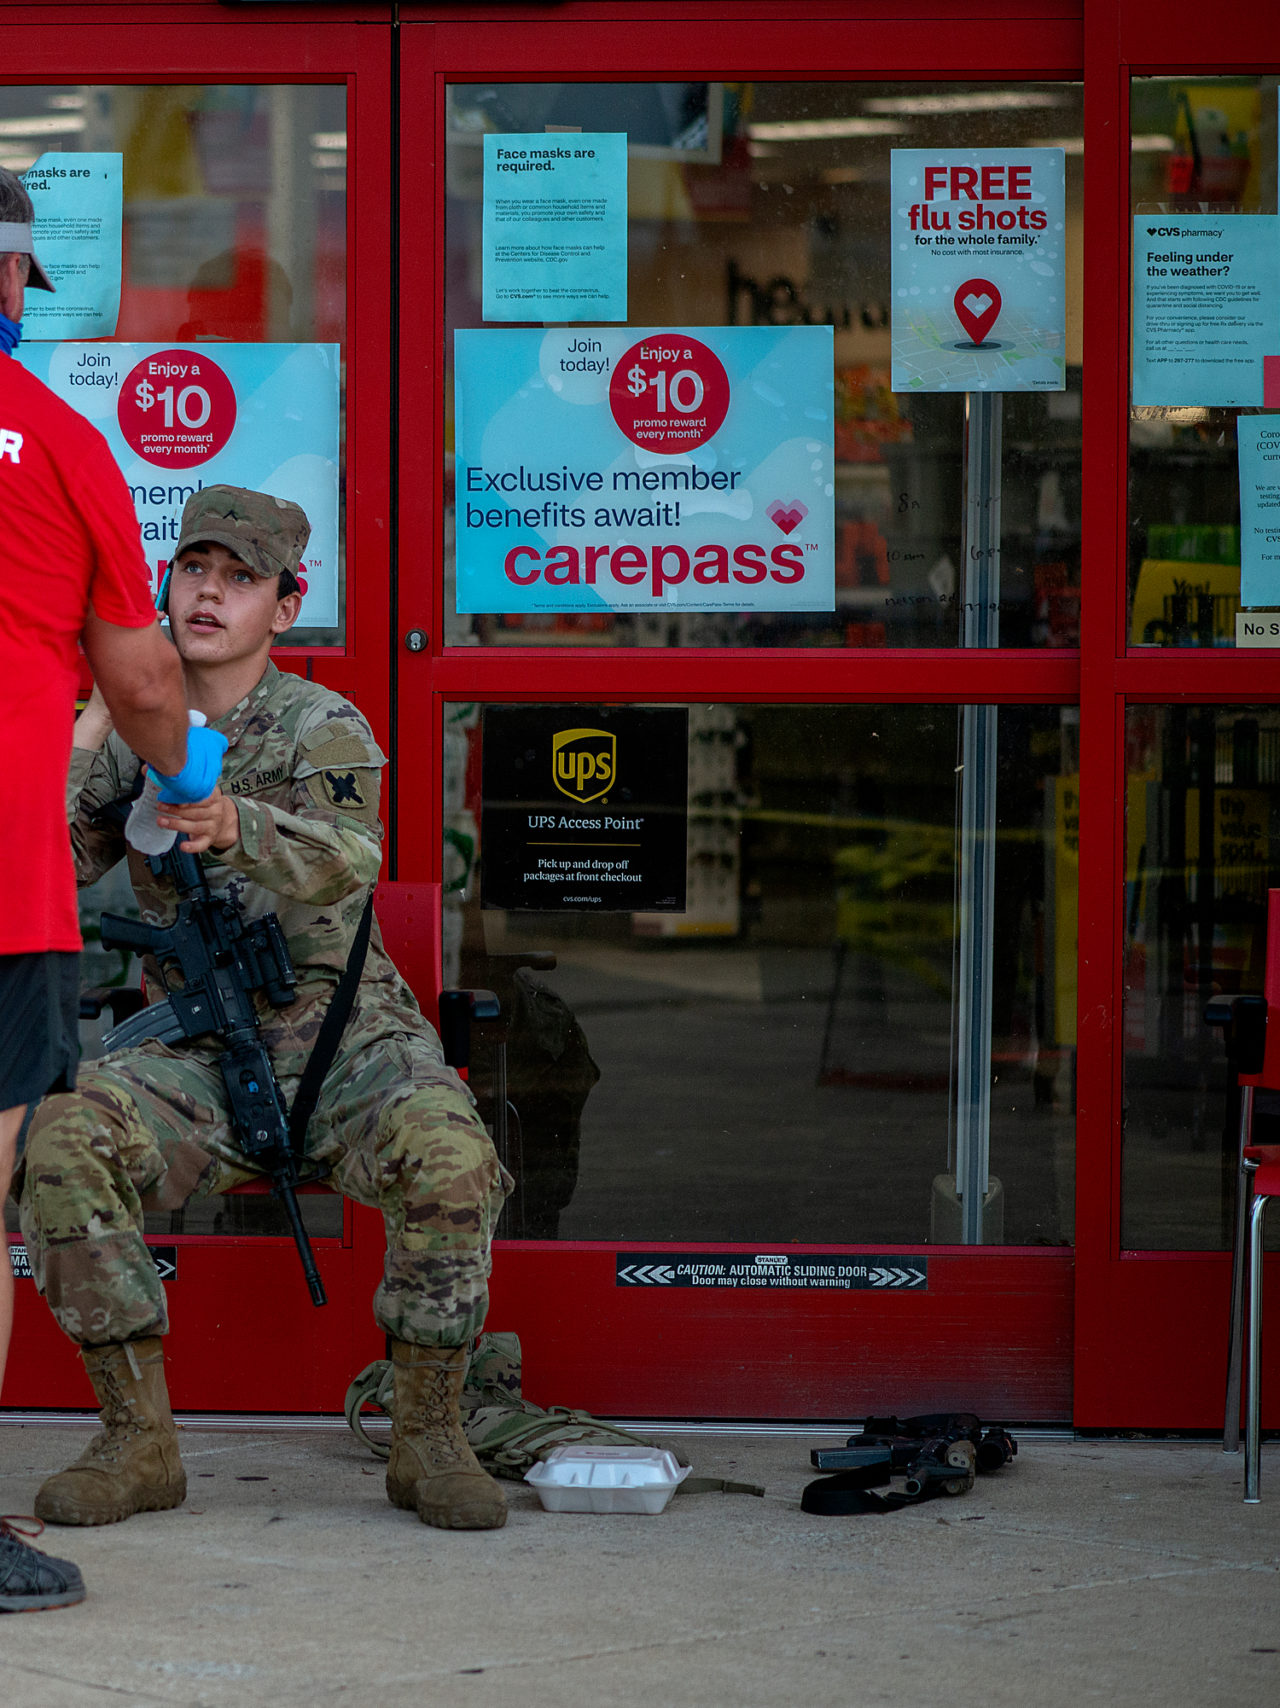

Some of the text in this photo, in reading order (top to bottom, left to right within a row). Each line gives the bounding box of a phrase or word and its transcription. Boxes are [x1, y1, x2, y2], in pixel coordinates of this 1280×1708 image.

[497, 148, 595, 159] Face masks are
[28, 167, 90, 177] masks are
[497, 160, 555, 174] required.
[24, 179, 50, 190] ired.
[924, 166, 1032, 200] FREE
[908, 204, 1047, 231] flu shots
[915, 235, 932, 245] for
[935, 234, 955, 245] the
[958, 234, 994, 245] whole
[1158, 228, 1224, 238] CVS pharmacy
[1147, 252, 1234, 264] Feeling under
[1147, 266, 1230, 276] the weather?
[567, 338, 602, 353] Join
[77, 353, 111, 367] Join
[640, 347, 692, 362] Enjoy a
[149, 362, 200, 377] Enjoy a
[560, 357, 610, 374] today!
[69, 371, 119, 388] today!
[627, 364, 704, 413] $10
[135, 379, 211, 428] $10
[633, 417, 706, 429] promo reward
[140, 432, 213, 445] promo reward
[636, 430, 665, 441] every
[144, 445, 172, 456] every
[466, 466, 741, 492] Exclusive member
[466, 500, 681, 527] benefits await!
[1244, 623, 1265, 635] No
[558, 752, 611, 790] ups
[231, 766, 286, 794] U.S. ARMY
[528, 816, 555, 828] UPS
[558, 816, 601, 829] Access
[538, 860, 629, 871] Pick up and drop off
[523, 872, 642, 882] packages at front checkout
[563, 895, 601, 903] cvs.com/ups
[756, 1256, 787, 1264] STANLEY
[677, 1265, 867, 1277] CAUTION: AUTOMATIC SLIDING DOOR
[692, 1276, 851, 1289] Door may close without warning
